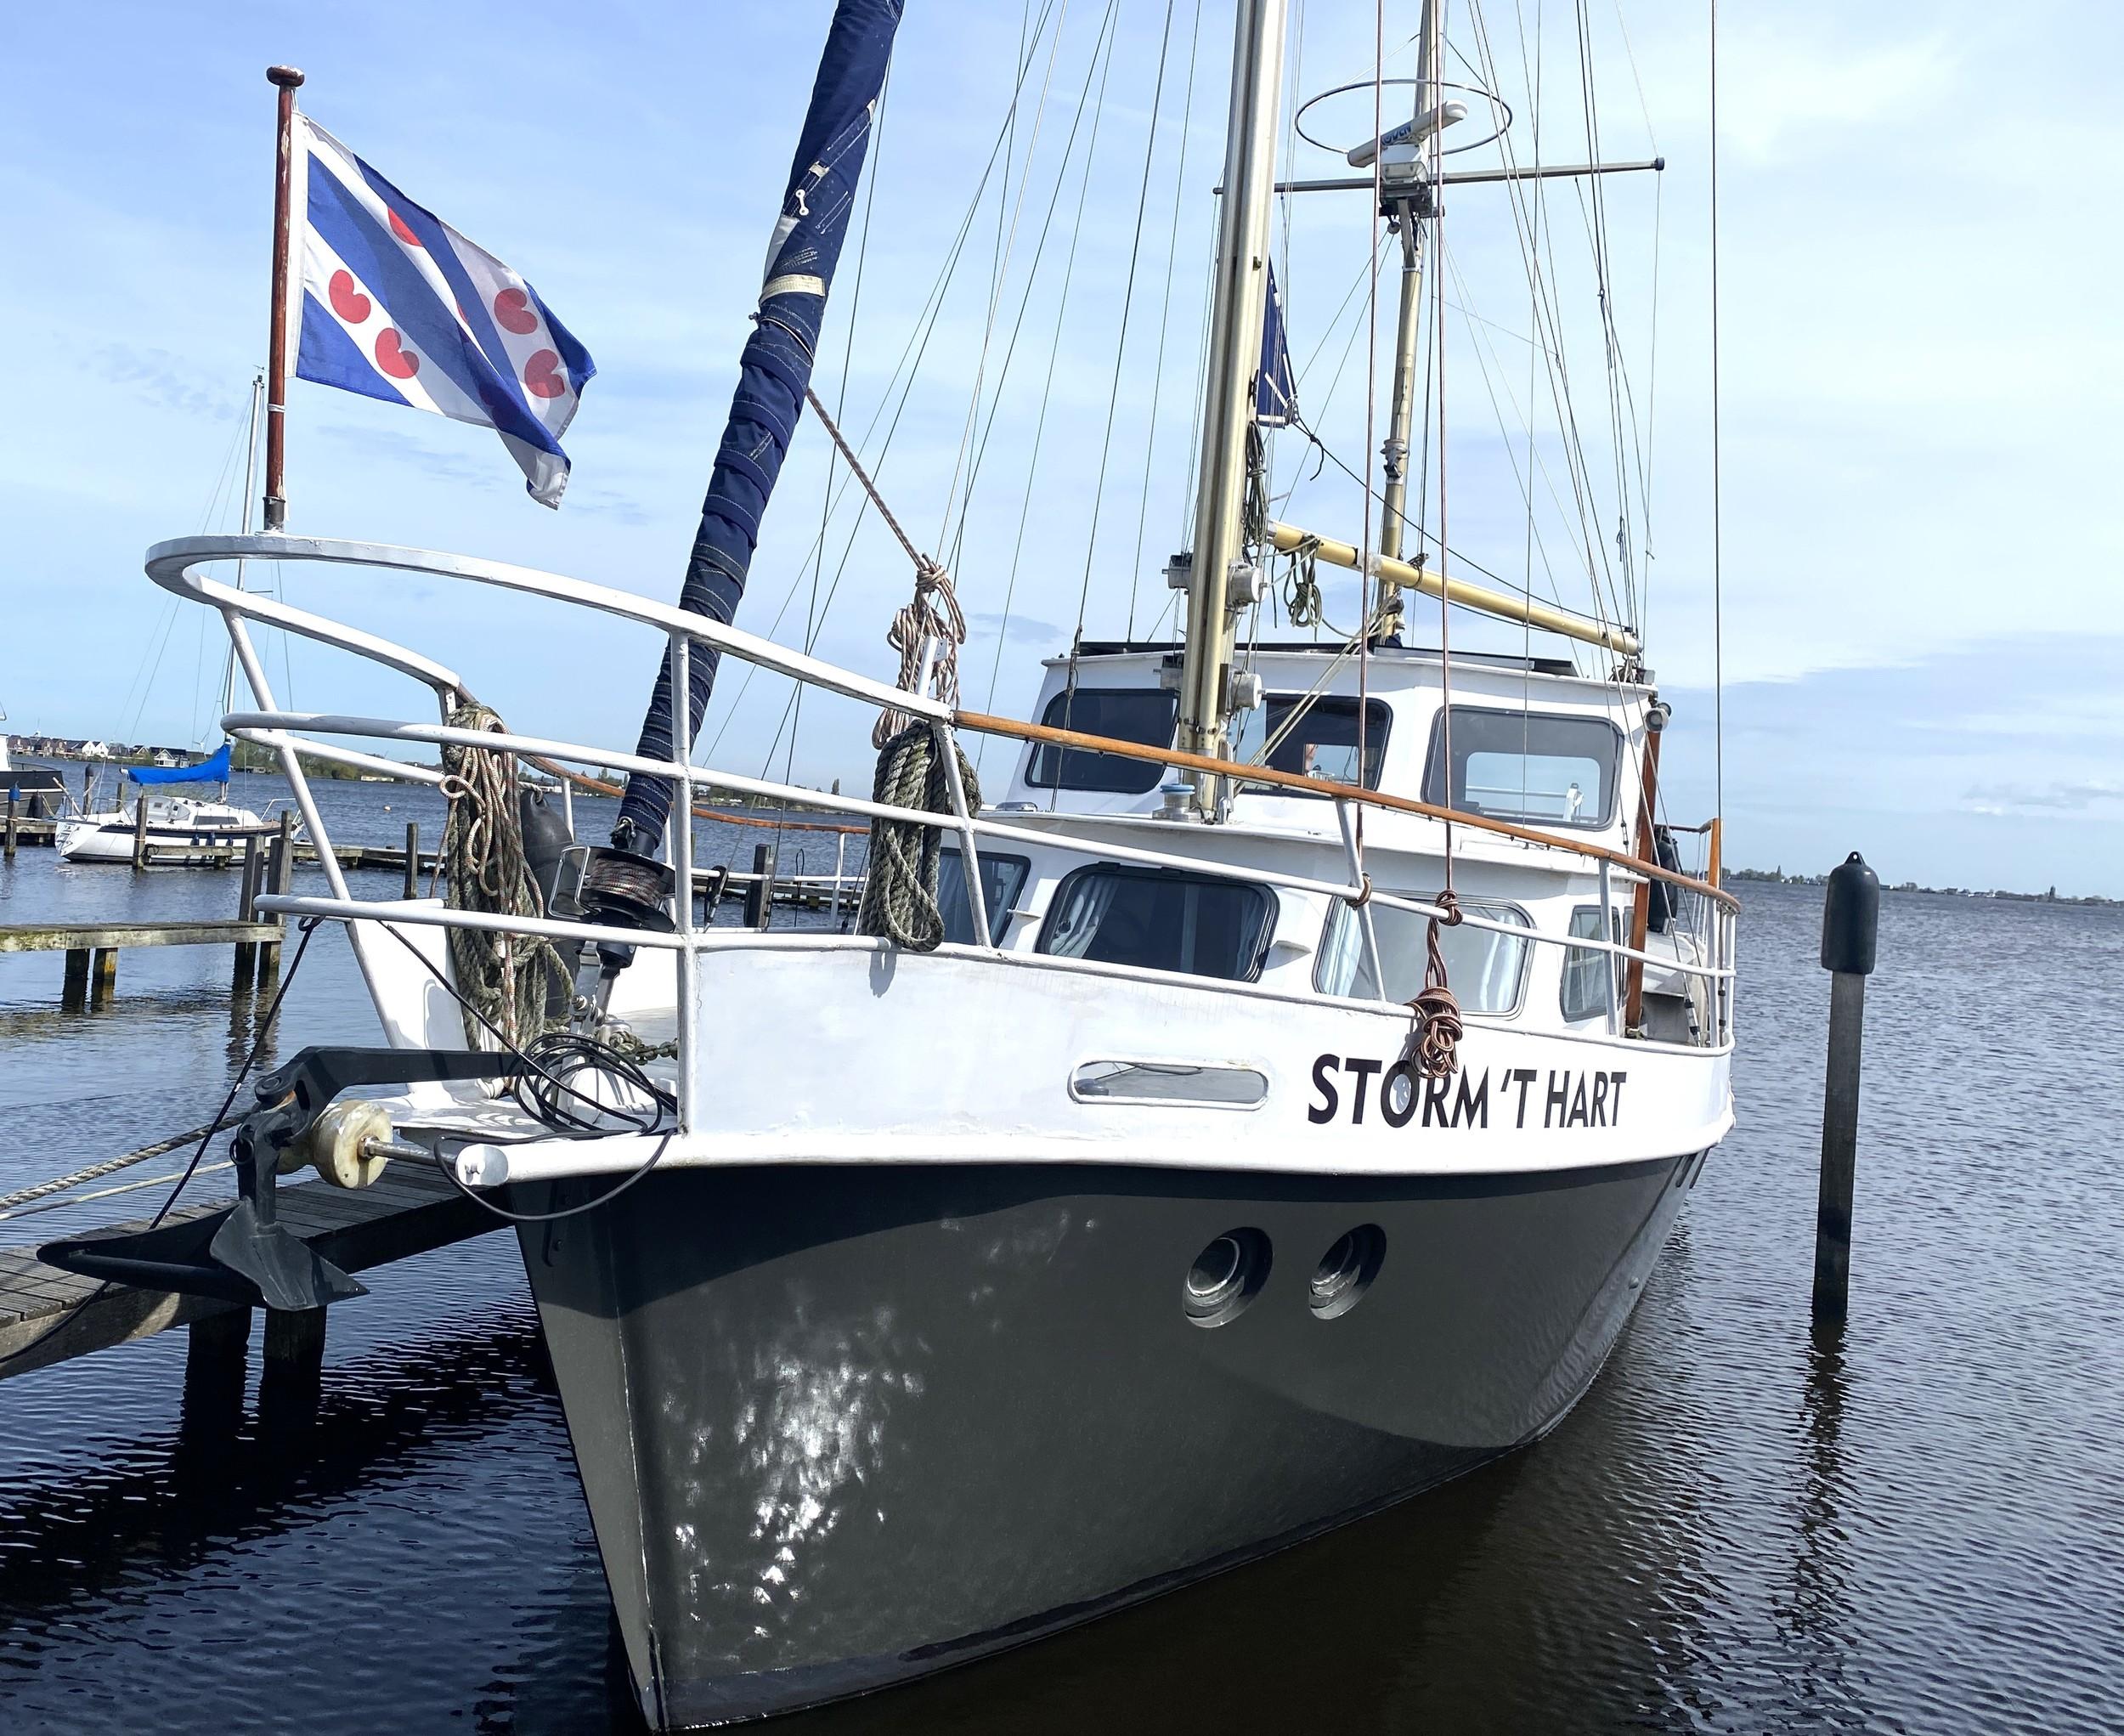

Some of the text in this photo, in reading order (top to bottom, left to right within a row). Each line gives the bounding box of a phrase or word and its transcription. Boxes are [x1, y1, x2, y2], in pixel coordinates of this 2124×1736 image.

[1308, 1053, 1628, 1129] STORM 'T HART
